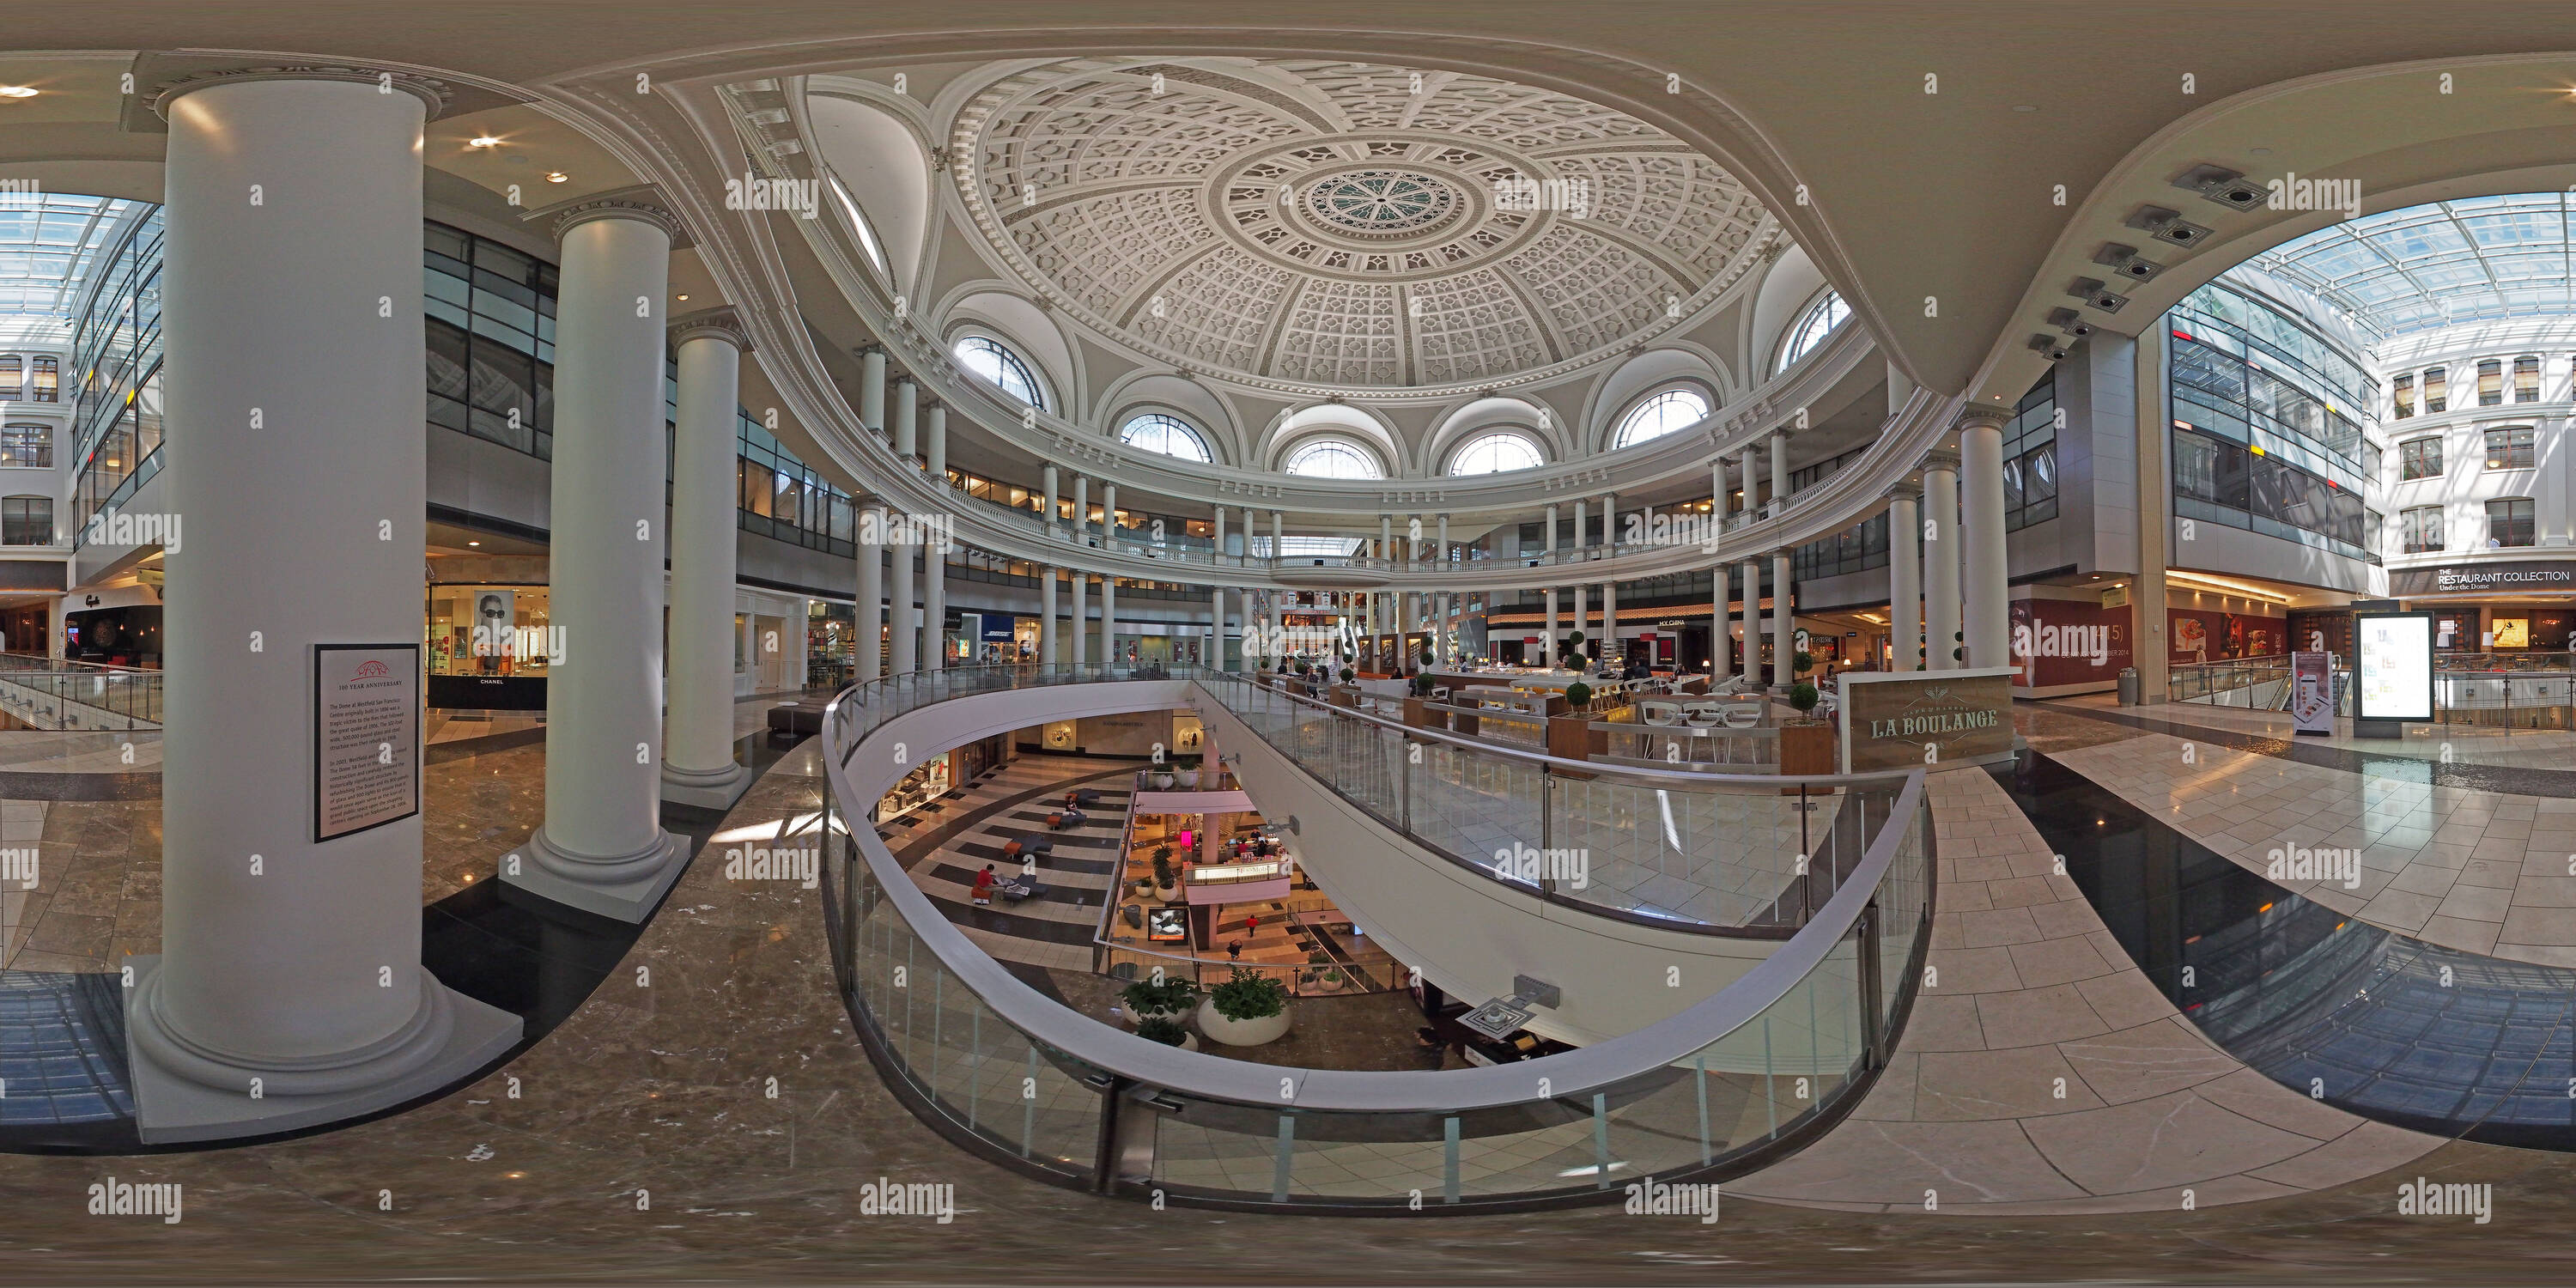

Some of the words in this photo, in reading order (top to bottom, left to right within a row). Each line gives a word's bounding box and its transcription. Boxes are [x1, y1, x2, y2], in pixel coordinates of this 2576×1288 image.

[2439, 573, 2502, 584] RESTAURANT
[2504, 571, 2570, 582] COLLECTION
[1871, 720, 1898, 738] LA
[1902, 709, 1998, 736] BOULANGE
